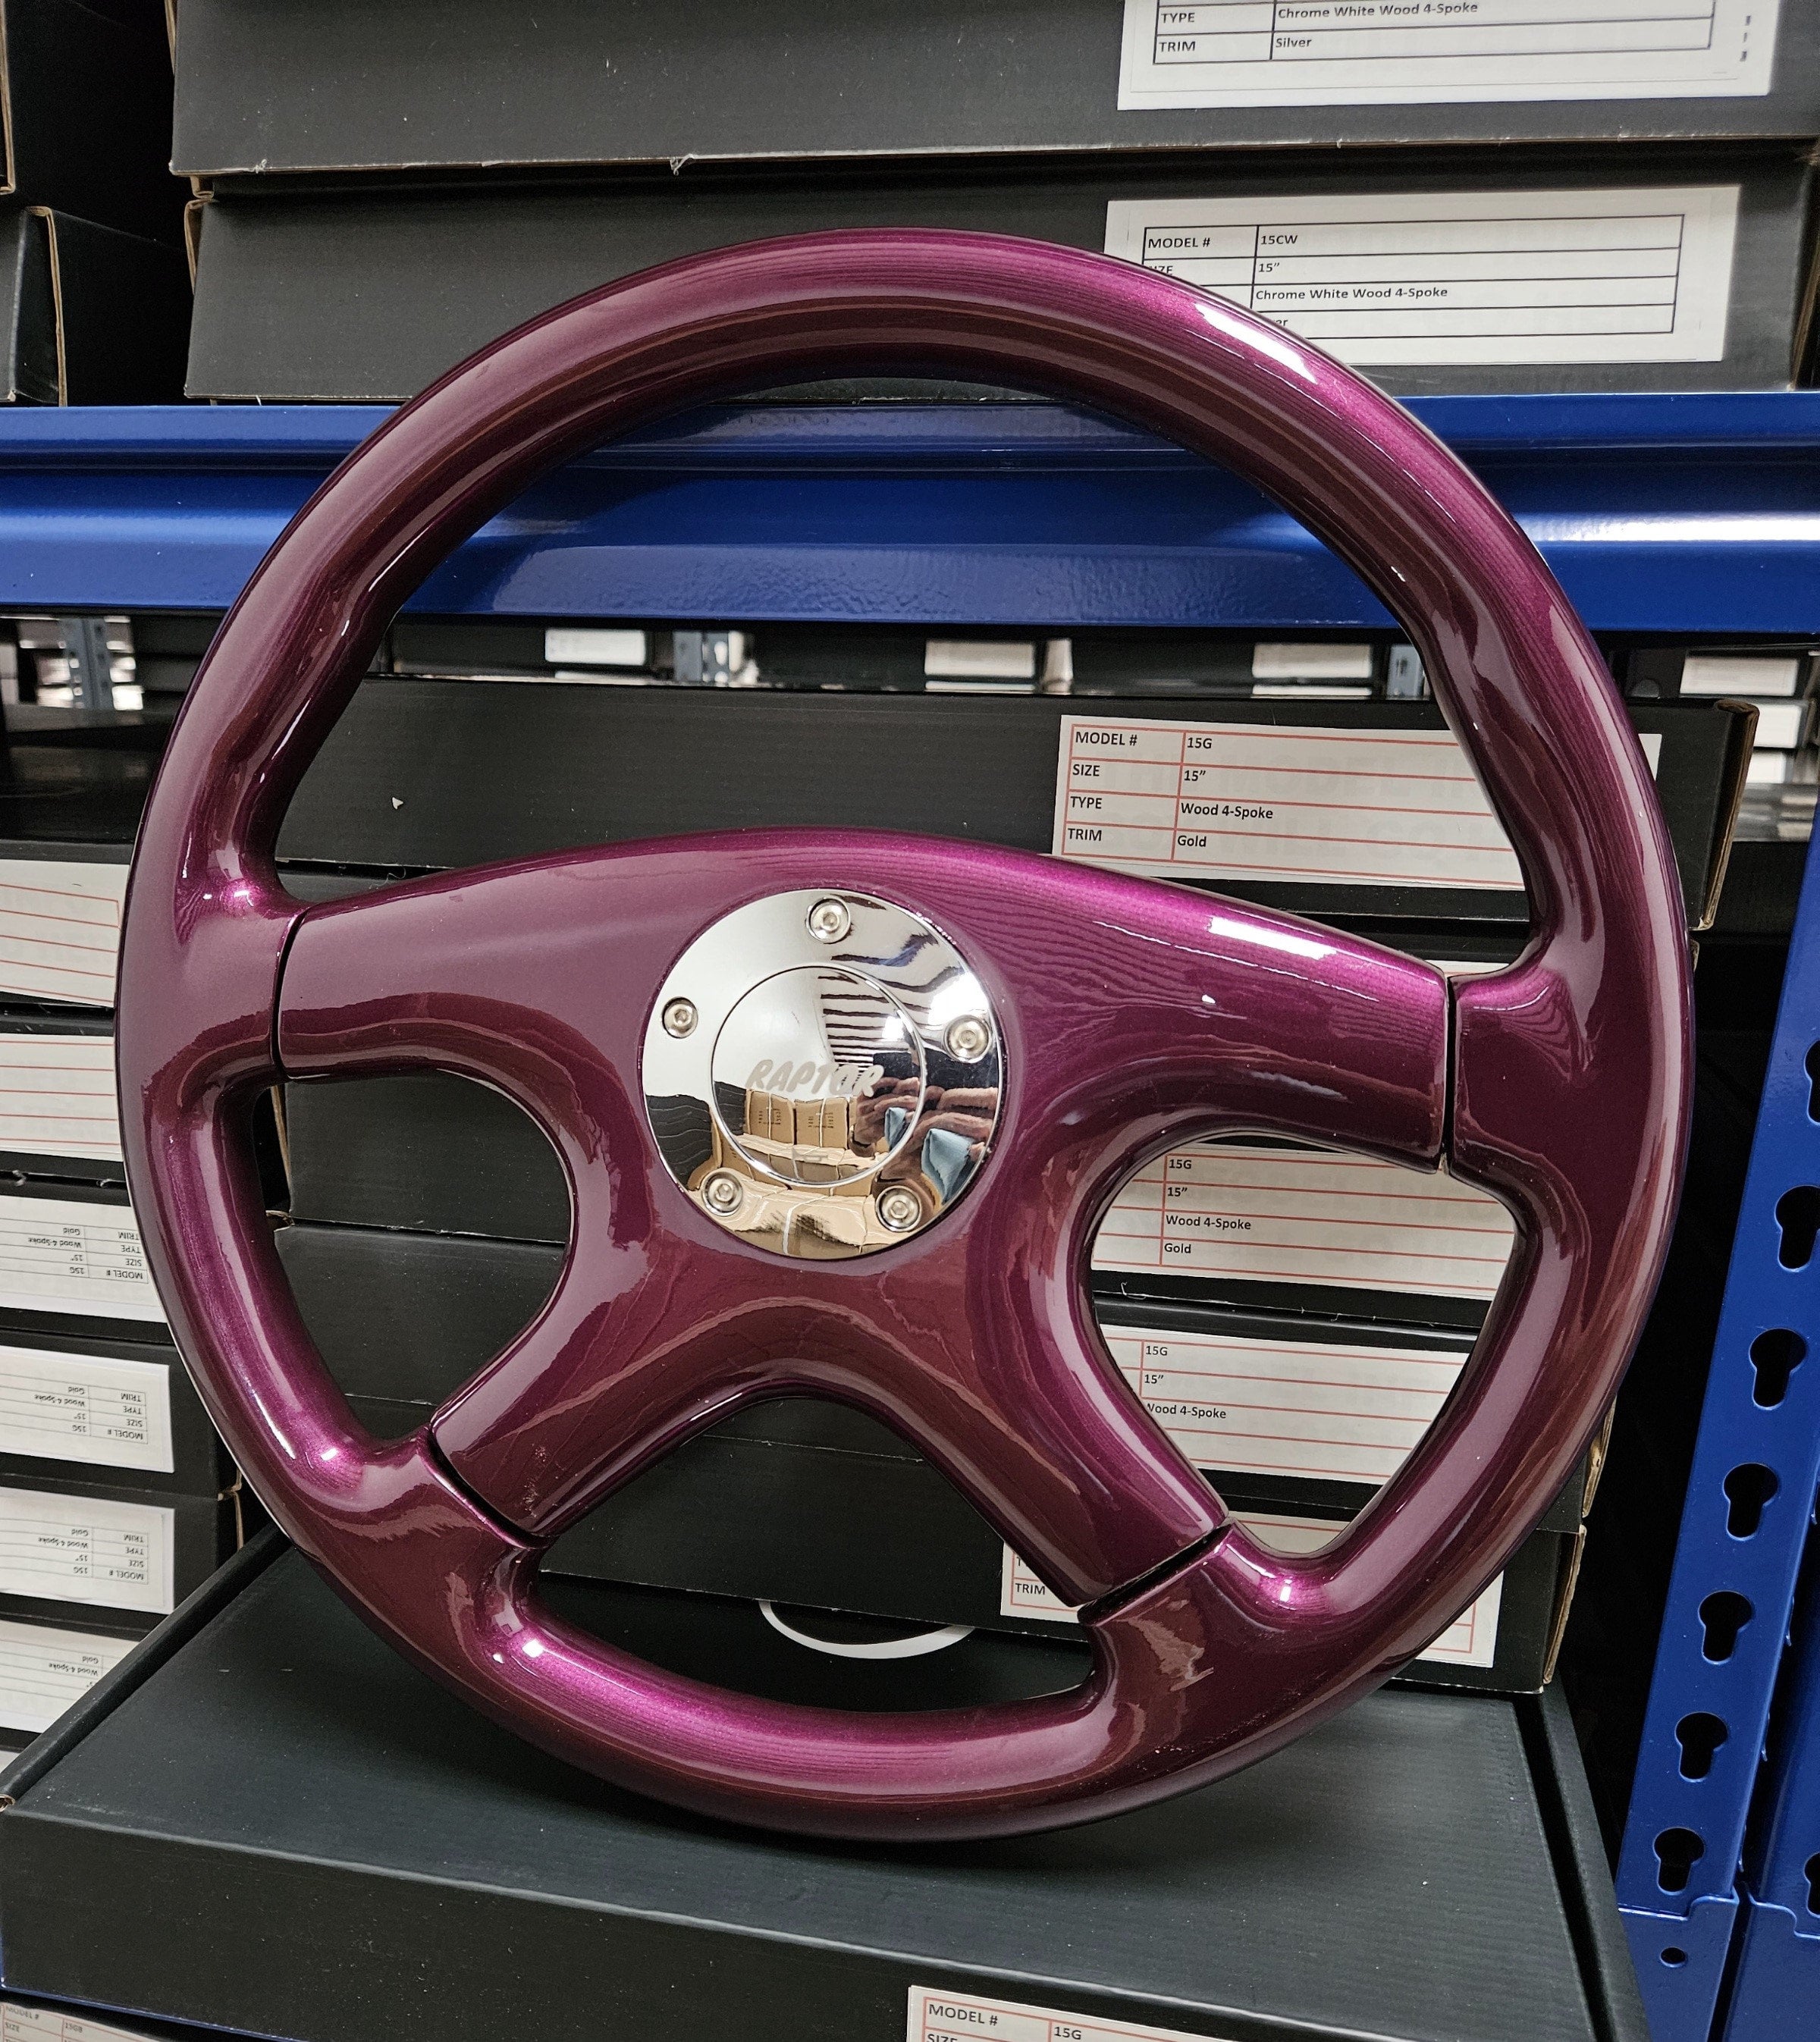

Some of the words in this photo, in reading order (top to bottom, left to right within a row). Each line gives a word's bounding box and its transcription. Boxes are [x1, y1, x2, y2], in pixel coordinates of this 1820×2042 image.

[1278, 8, 1330, 19] Chrome
[1334, 5, 1375, 17] White
[1379, 3, 1420, 15] Wood
[1423, 2, 1478, 16] 4-Spoke
[1161, 12, 1195, 24] TYPE
[1159, 41, 1196, 52] TRIM
[1276, 37, 1312, 48] Silver
[1148, 237, 1199, 249] MODEL
[1202, 237, 1210, 247] #
[1260, 234, 1298, 245] 15CW
[1148, 265, 1174, 276] ZE
[1256, 290, 1306, 300] Chrome
[1309, 289, 1348, 299] White
[1352, 287, 1392, 298] Wood
[1395, 287, 1448, 300] 4-Spoke
[1075, 731, 1125, 746] MODEL
[1129, 734, 1138, 746] #
[1187, 737, 1213, 749] 15G
[1072, 764, 1100, 777] SIZE
[1070, 795, 1103, 810] TYPE
[1181, 802, 1219, 816] Wood
[1222, 805, 1273, 820] 4-Spoke
[1067, 827, 1103, 842] TRIM
[1177, 835, 1207, 848] Gold
[745, 1059, 884, 1097] RAPTOR
[1169, 1159, 1192, 1170] 15G
[1166, 1215, 1201, 1227] Wood
[1203, 1217, 1251, 1231] 4-Spoke
[118, 1231, 140, 1241] TRIM
[121, 1245, 142, 1253] TYPE
[1164, 1242, 1191, 1254] Gold
[126, 1258, 142, 1266] SIZE
[113, 1269, 143, 1279] MODEL
[1145, 1345, 1168, 1357] 15G
[121, 1393, 142, 1402] TRIM
[123, 1406, 142, 1414] TYPE
[1180, 1405, 1227, 1419] 4-Spoke
[126, 1419, 143, 1427] SIZE
[114, 1429, 143, 1440] MODEL
[116, 1570, 144, 1580] MODEL
[1015, 1582, 1046, 1595] TRIM
[929, 2003, 985, 2025] MODEL
[989, 2015, 998, 2026] #
[1053, 2026, 1081, 2040] 15G
